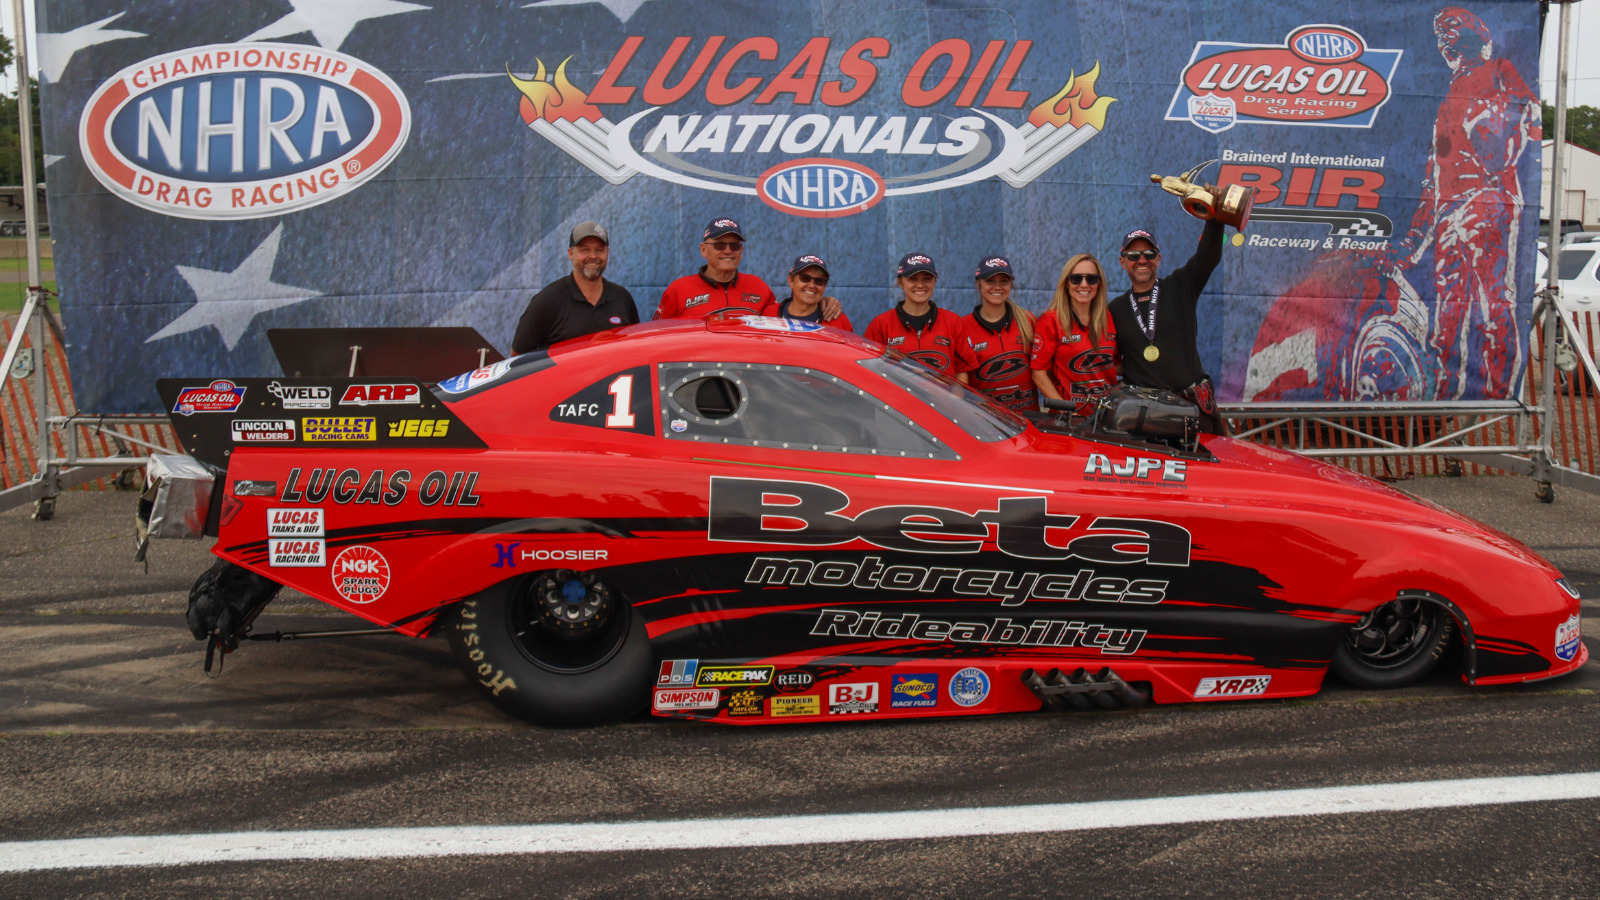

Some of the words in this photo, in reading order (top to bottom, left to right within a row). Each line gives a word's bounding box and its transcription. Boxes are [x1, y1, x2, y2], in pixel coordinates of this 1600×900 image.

[1301, 33, 1354, 57] NHRA
[132, 49, 347, 88] CHAMPIONSHIP
[585, 35, 892, 107] LUCAS
[900, 38, 1034, 108] OIL
[1198, 63, 1315, 94] LUCAS
[1316, 68, 1369, 97] OIL
[1243, 95, 1287, 107] Drag
[1295, 97, 1358, 109] Racing
[1197, 105, 1231, 116] LUCAS
[1266, 107, 1325, 117] Series
[137, 77, 352, 174] NHRA
[641, 114, 986, 156] NATIONALS
[1222, 150, 1286, 164] Brainerd
[1290, 151, 1385, 168] International
[137, 175, 213, 208] DRAG
[231, 168, 340, 208] RACING
[775, 169, 868, 205] NHRA
[1217, 164, 1386, 209] BIR
[1248, 233, 1320, 250] Raceway
[1322, 237, 1333, 249] &
[1338, 238, 1388, 251] Resort
[686, 293, 710, 307] AJPE
[182, 393, 219, 403] LUCAS
[218, 393, 236, 403] OIL
[278, 387, 330, 400] WELD
[343, 385, 419, 401] ARP
[605, 374, 635, 429] 1
[557, 403, 599, 418] TAFC
[234, 421, 284, 431] LINCOLN
[304, 418, 375, 433] BULLET
[388, 419, 450, 438] JEGS
[246, 432, 290, 441] WELDERS
[1083, 452, 1188, 482] AJPE
[280, 467, 412, 506] LUCAS
[418, 470, 481, 506] OIL
[273, 511, 319, 525] LUCAS
[707, 475, 1192, 566] Beta
[271, 525, 296, 533] TRANS
[303, 525, 320, 533] DIFF
[274, 541, 320, 555] LUCAS
[521, 549, 609, 561] HOOSIER
[275, 555, 306, 563] RACING
[307, 555, 320, 563] OIL
[341, 559, 379, 574] NGK
[343, 577, 380, 586] SPARK
[744, 556, 1170, 607] motorcycles
[343, 586, 380, 594] PLUGS
[808, 608, 1148, 655] Rideability
[660, 674, 693, 682] PDS
[712, 670, 768, 682] RACEPAK
[777, 673, 813, 685] REID
[835, 684, 874, 703] B&J
[895, 684, 934, 693] SUNOCO
[1208, 678, 1257, 695] XRP
[659, 691, 714, 704] SIMPSON
